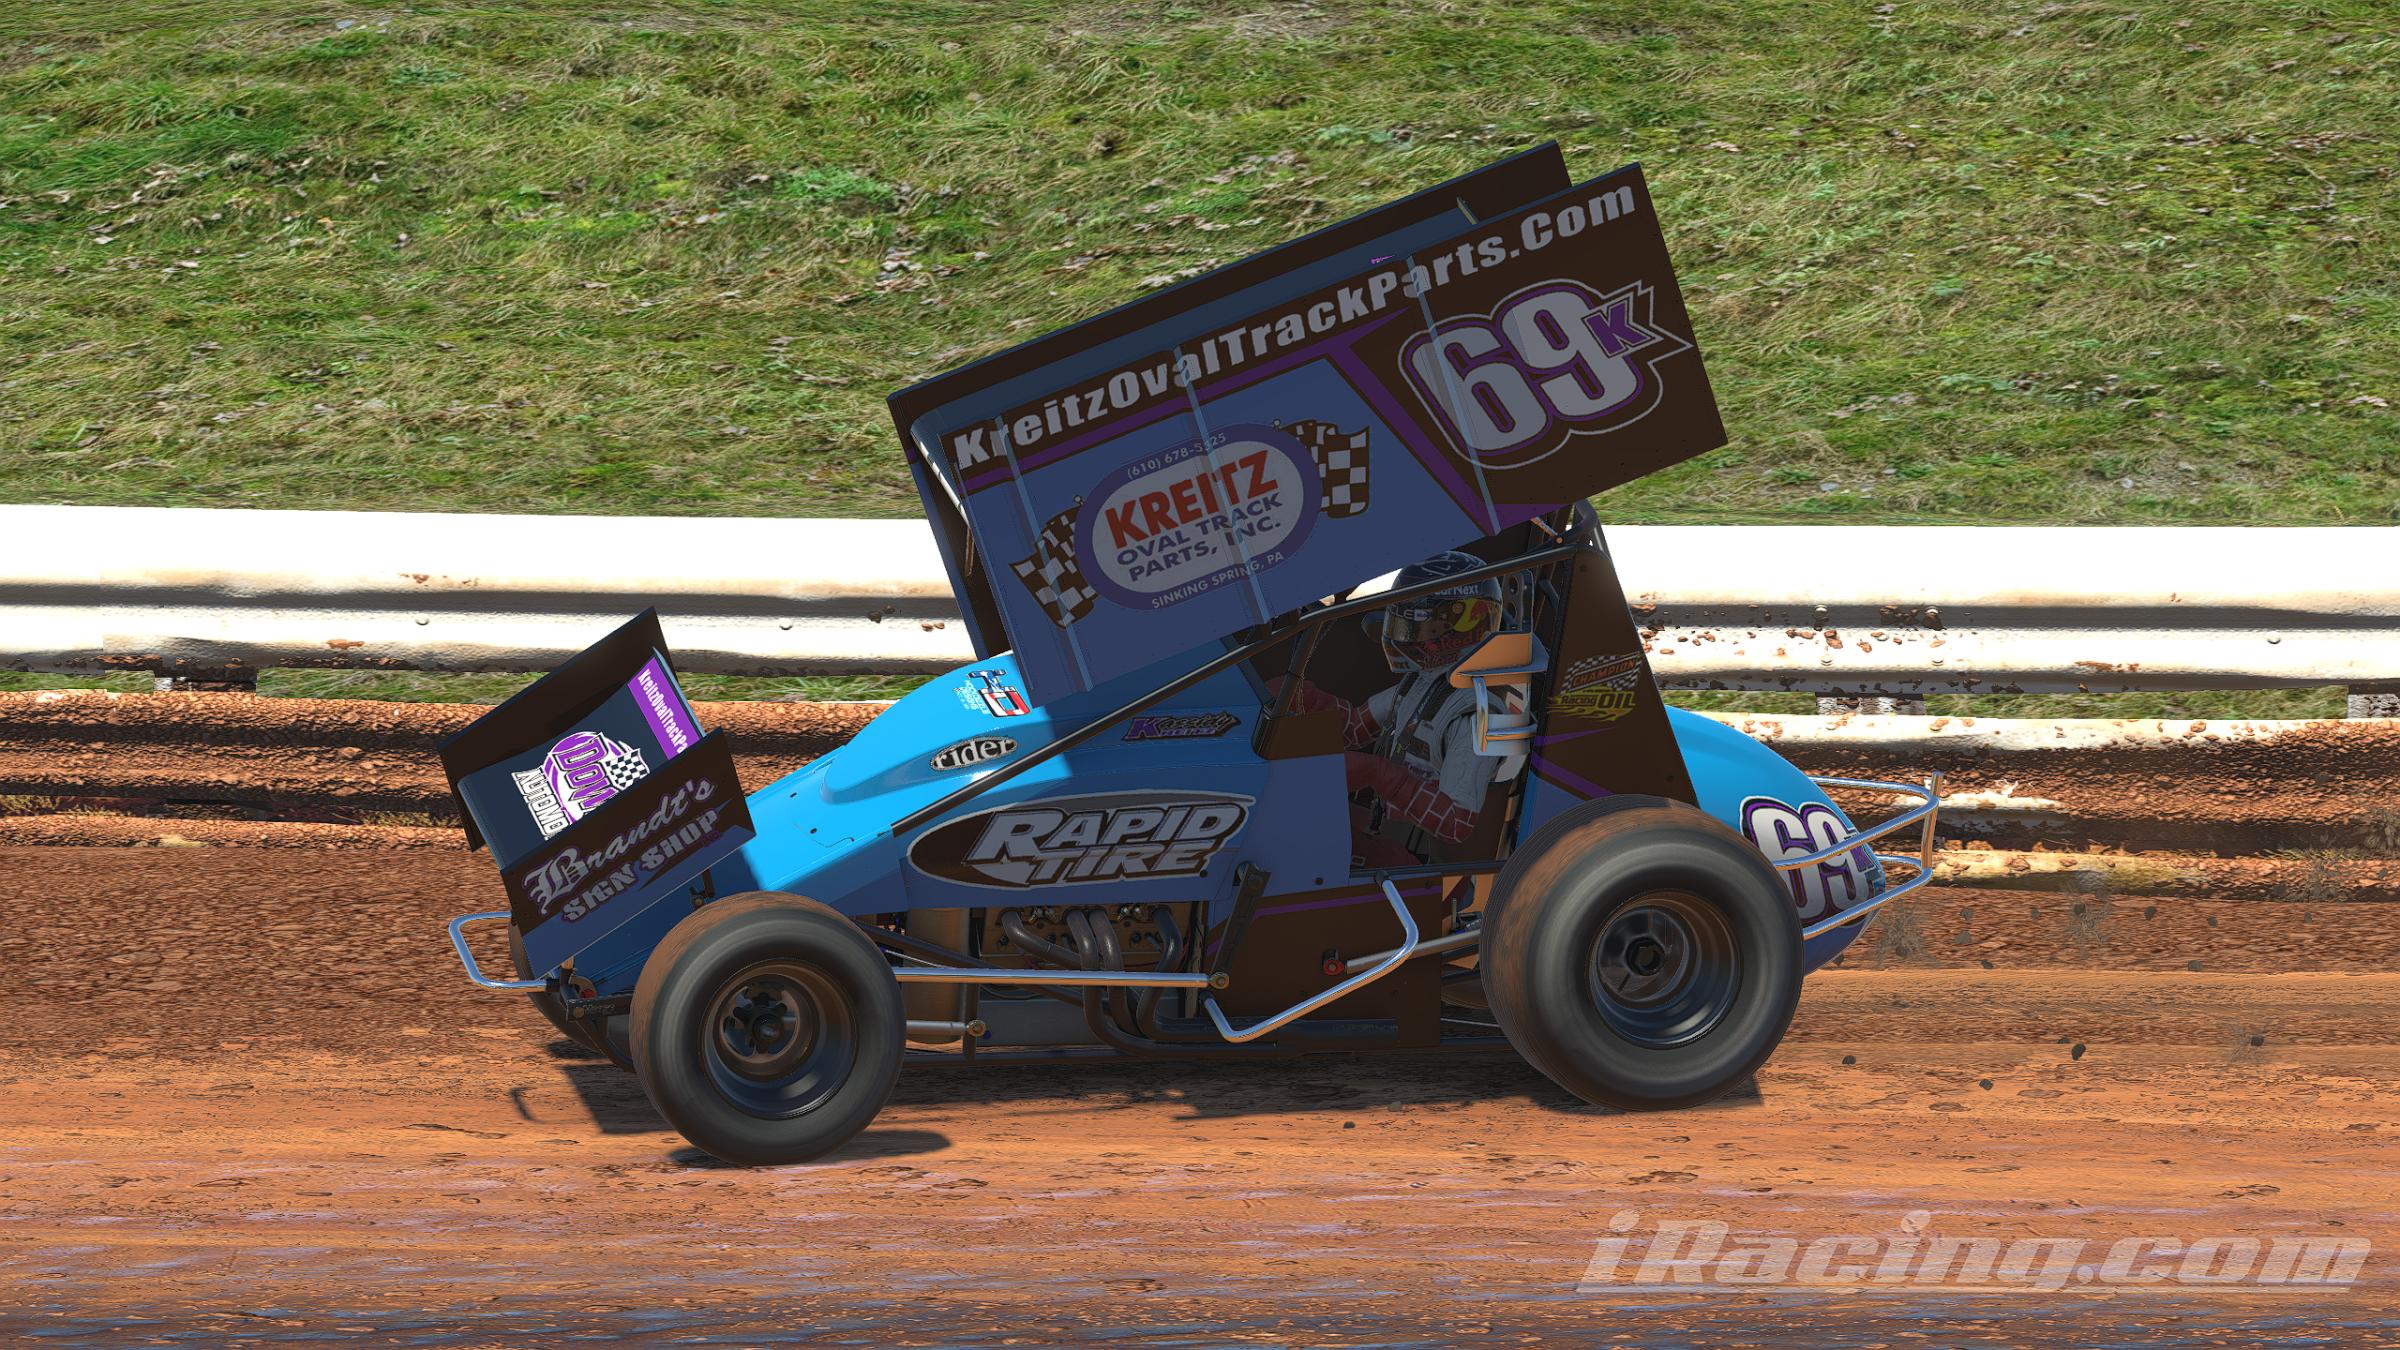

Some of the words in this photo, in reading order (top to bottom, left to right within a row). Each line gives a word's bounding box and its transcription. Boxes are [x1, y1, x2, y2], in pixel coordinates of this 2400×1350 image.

[953, 185, 1636, 470] KreitzOvalTrackParts.Com
[1127, 457, 1161, 480] (610)
[1105, 450, 1279, 549] KREITZ
[1116, 531, 1191, 566] OVAL
[1195, 493, 1283, 536] TRACK
[1128, 541, 1218, 583] PARTS,
[1225, 516, 1281, 546] INC.
[1151, 579, 1209, 609] SINKING
[1211, 559, 1265, 587] SPRING,
[1267, 551, 1285, 564] PA
[1560, 695, 1597, 705] Racing
[1597, 690, 1636, 709] OIL
[1572, 660, 1636, 687] CHAMPION
[936, 739, 1017, 769] rider
[523, 777, 714, 916] Brandt's
[964, 804, 1243, 864] RAPID
[1032, 839, 1216, 883] TIRE
[561, 861, 636, 922] SIGN
[639, 808, 719, 871] SHOP
